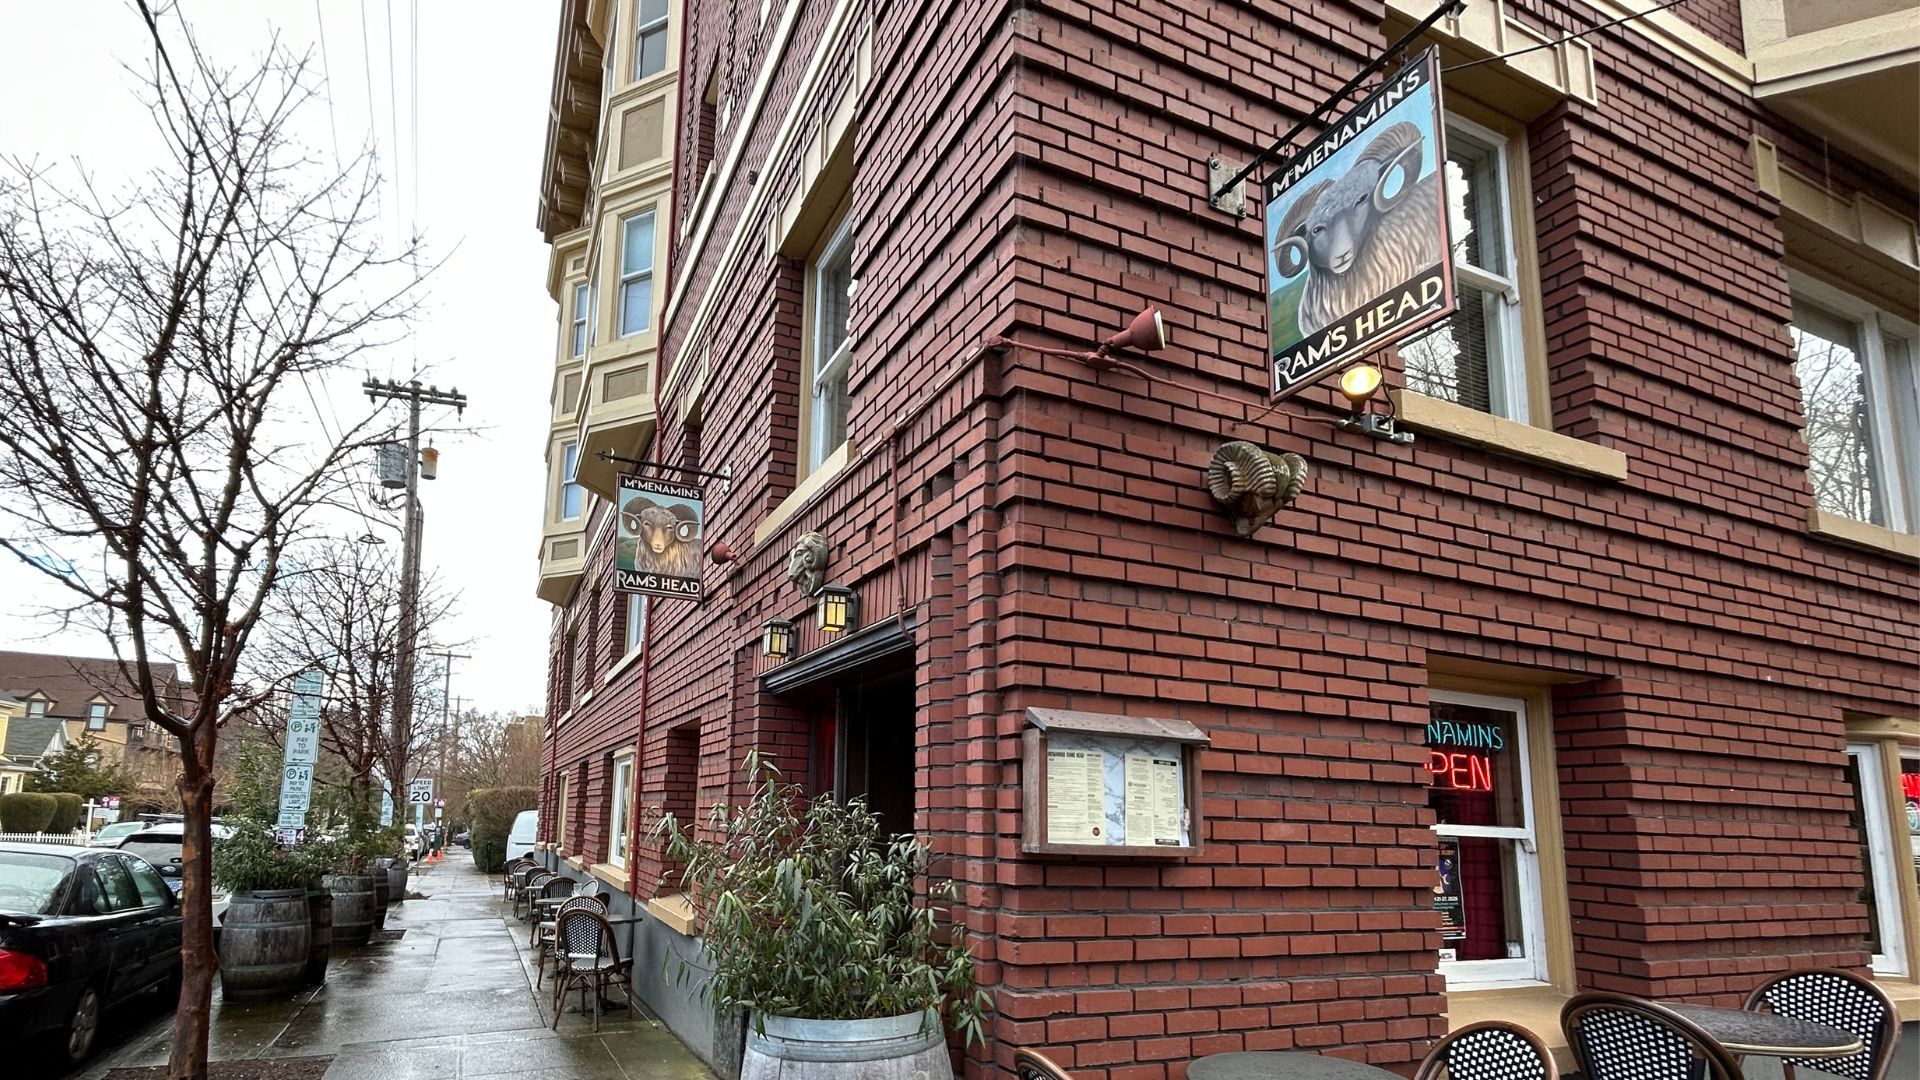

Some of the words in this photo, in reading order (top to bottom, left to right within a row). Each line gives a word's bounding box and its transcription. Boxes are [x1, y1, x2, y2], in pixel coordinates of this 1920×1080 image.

[1274, 325, 1348, 393] RAM'S
[1355, 275, 1443, 341] HEAD
[661, 577, 700, 593] HEAD
[1424, 751, 1491, 791] PEN
[410, 791, 431, 801] 20
